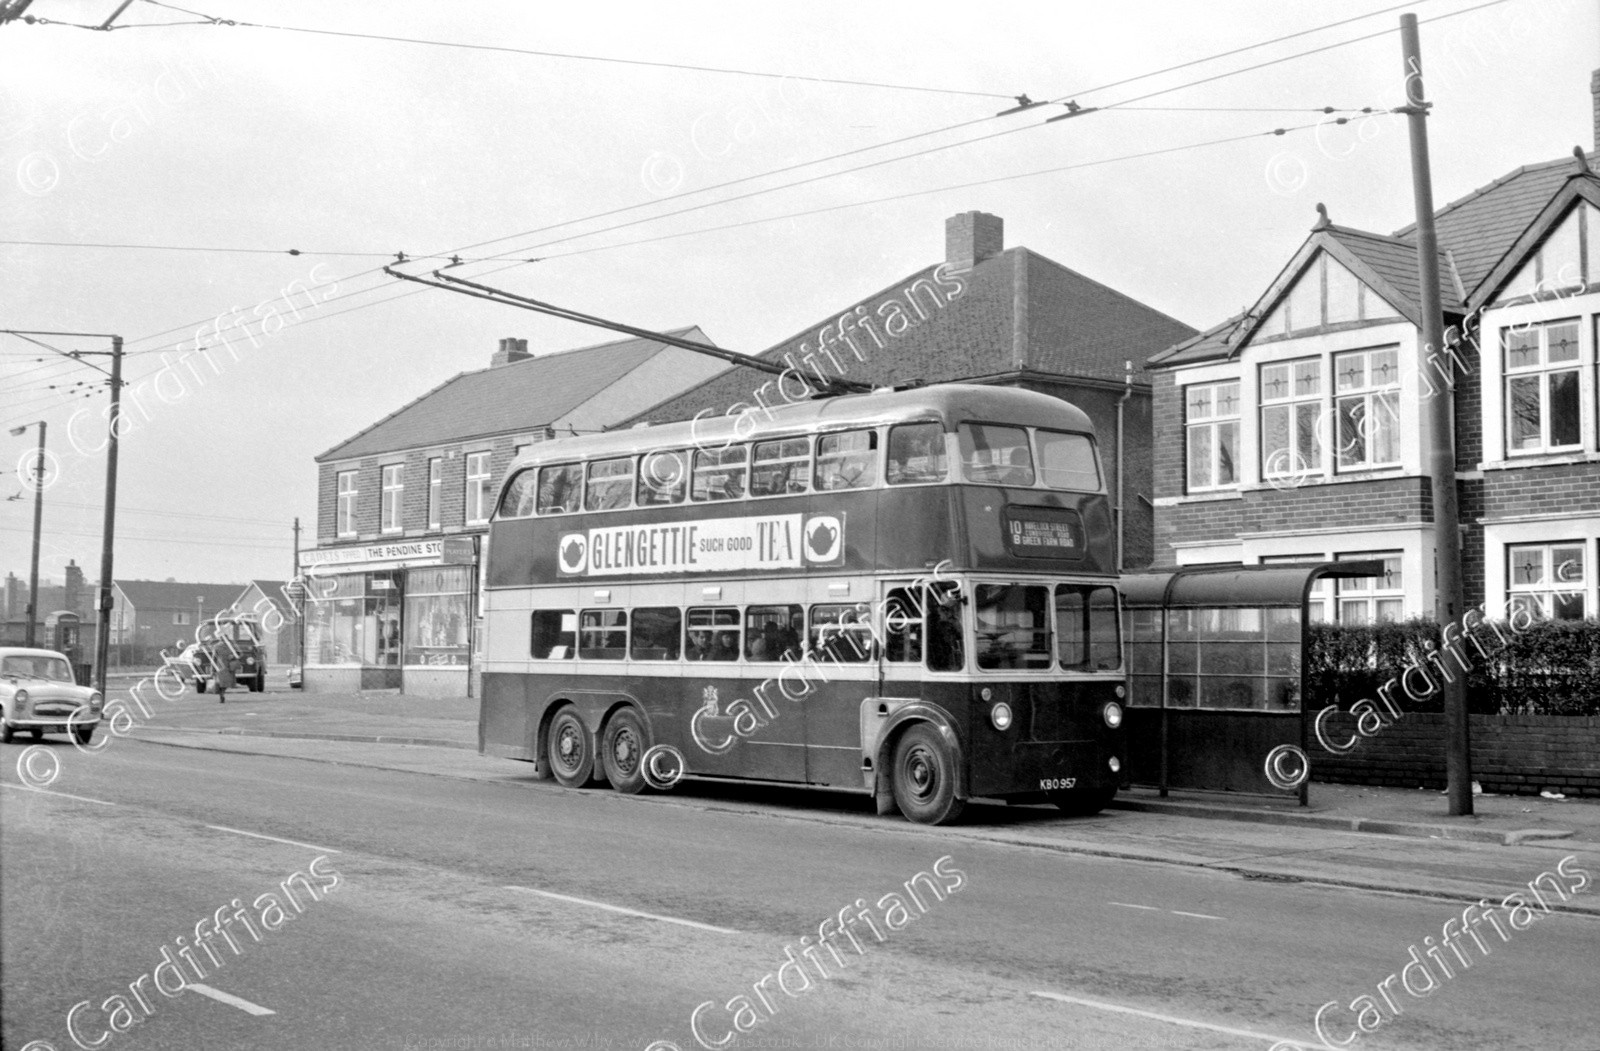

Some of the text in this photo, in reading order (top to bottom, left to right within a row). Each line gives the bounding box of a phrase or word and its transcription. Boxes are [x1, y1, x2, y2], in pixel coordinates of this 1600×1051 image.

[1009, 520, 1022, 534] 10
[367, 547, 383, 558] THE
[386, 544, 422, 557] PENDINE
[592, 520, 794, 570] GLENGETTIE SUCH GOOD TEA
[1040, 777, 1076, 790] KBO 957
